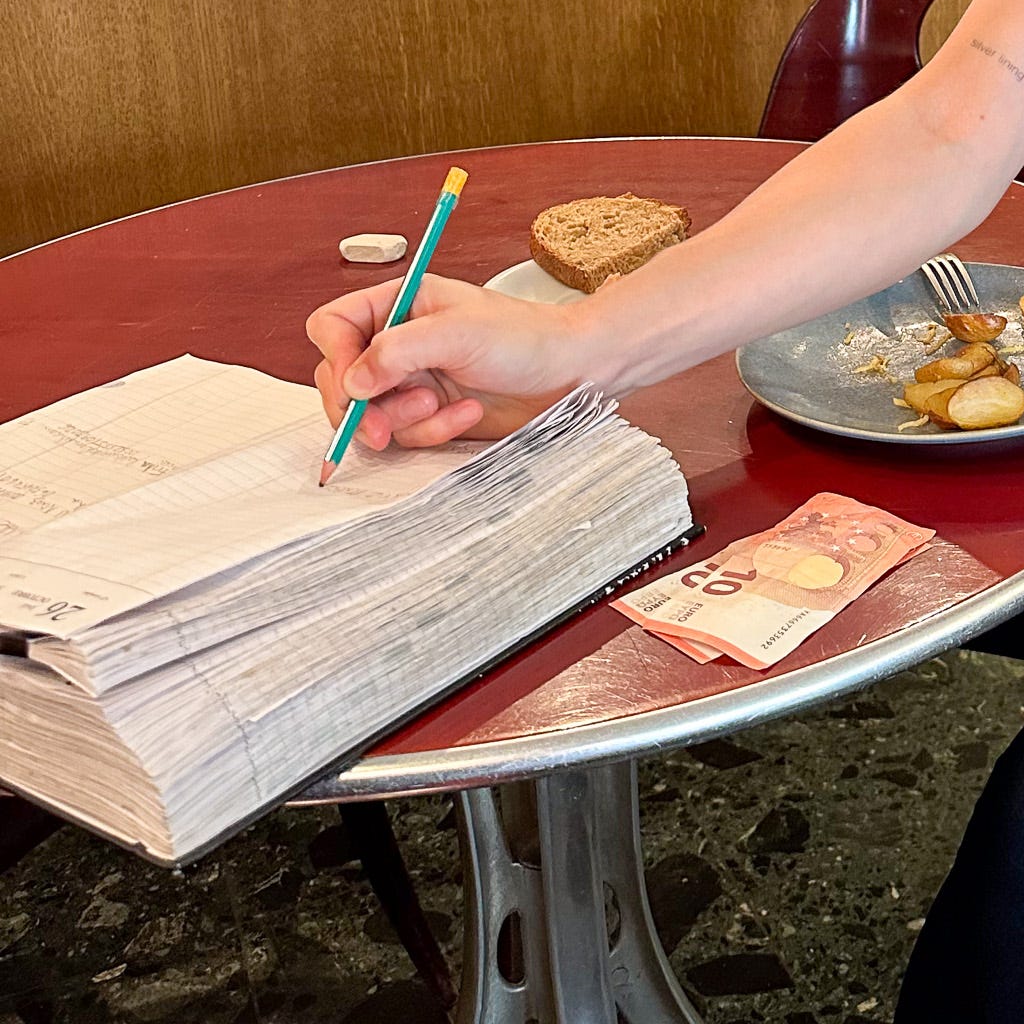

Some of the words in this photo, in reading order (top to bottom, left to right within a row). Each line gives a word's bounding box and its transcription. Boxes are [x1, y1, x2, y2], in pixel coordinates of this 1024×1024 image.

[970, 38, 997, 57] silver
[701, 568, 757, 596] 10
[34, 601, 87, 622] 26
[643, 596, 672, 613] EURO
[677, 602, 704, 623] EURO
